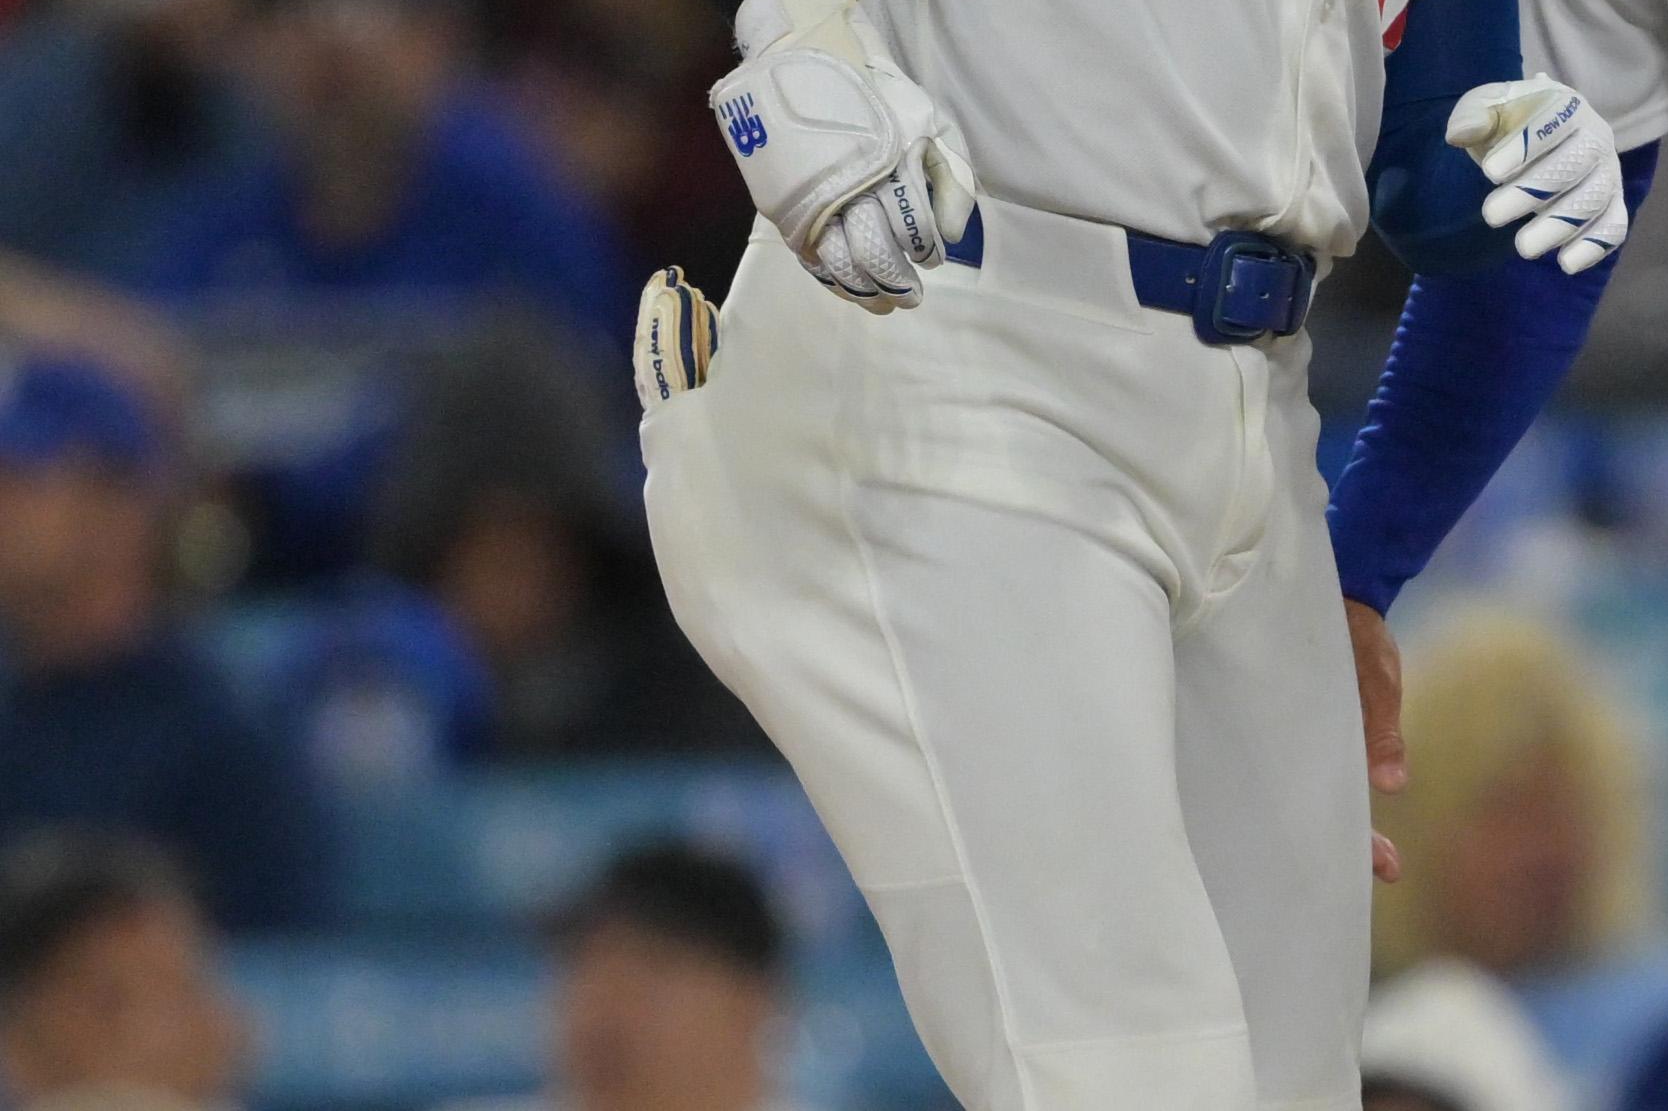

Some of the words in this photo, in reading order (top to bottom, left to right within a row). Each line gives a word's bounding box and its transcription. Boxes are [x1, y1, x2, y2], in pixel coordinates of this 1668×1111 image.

[1535, 116, 1560, 141] new
[893, 184, 926, 253] balance
[652, 358, 671, 400] bala
